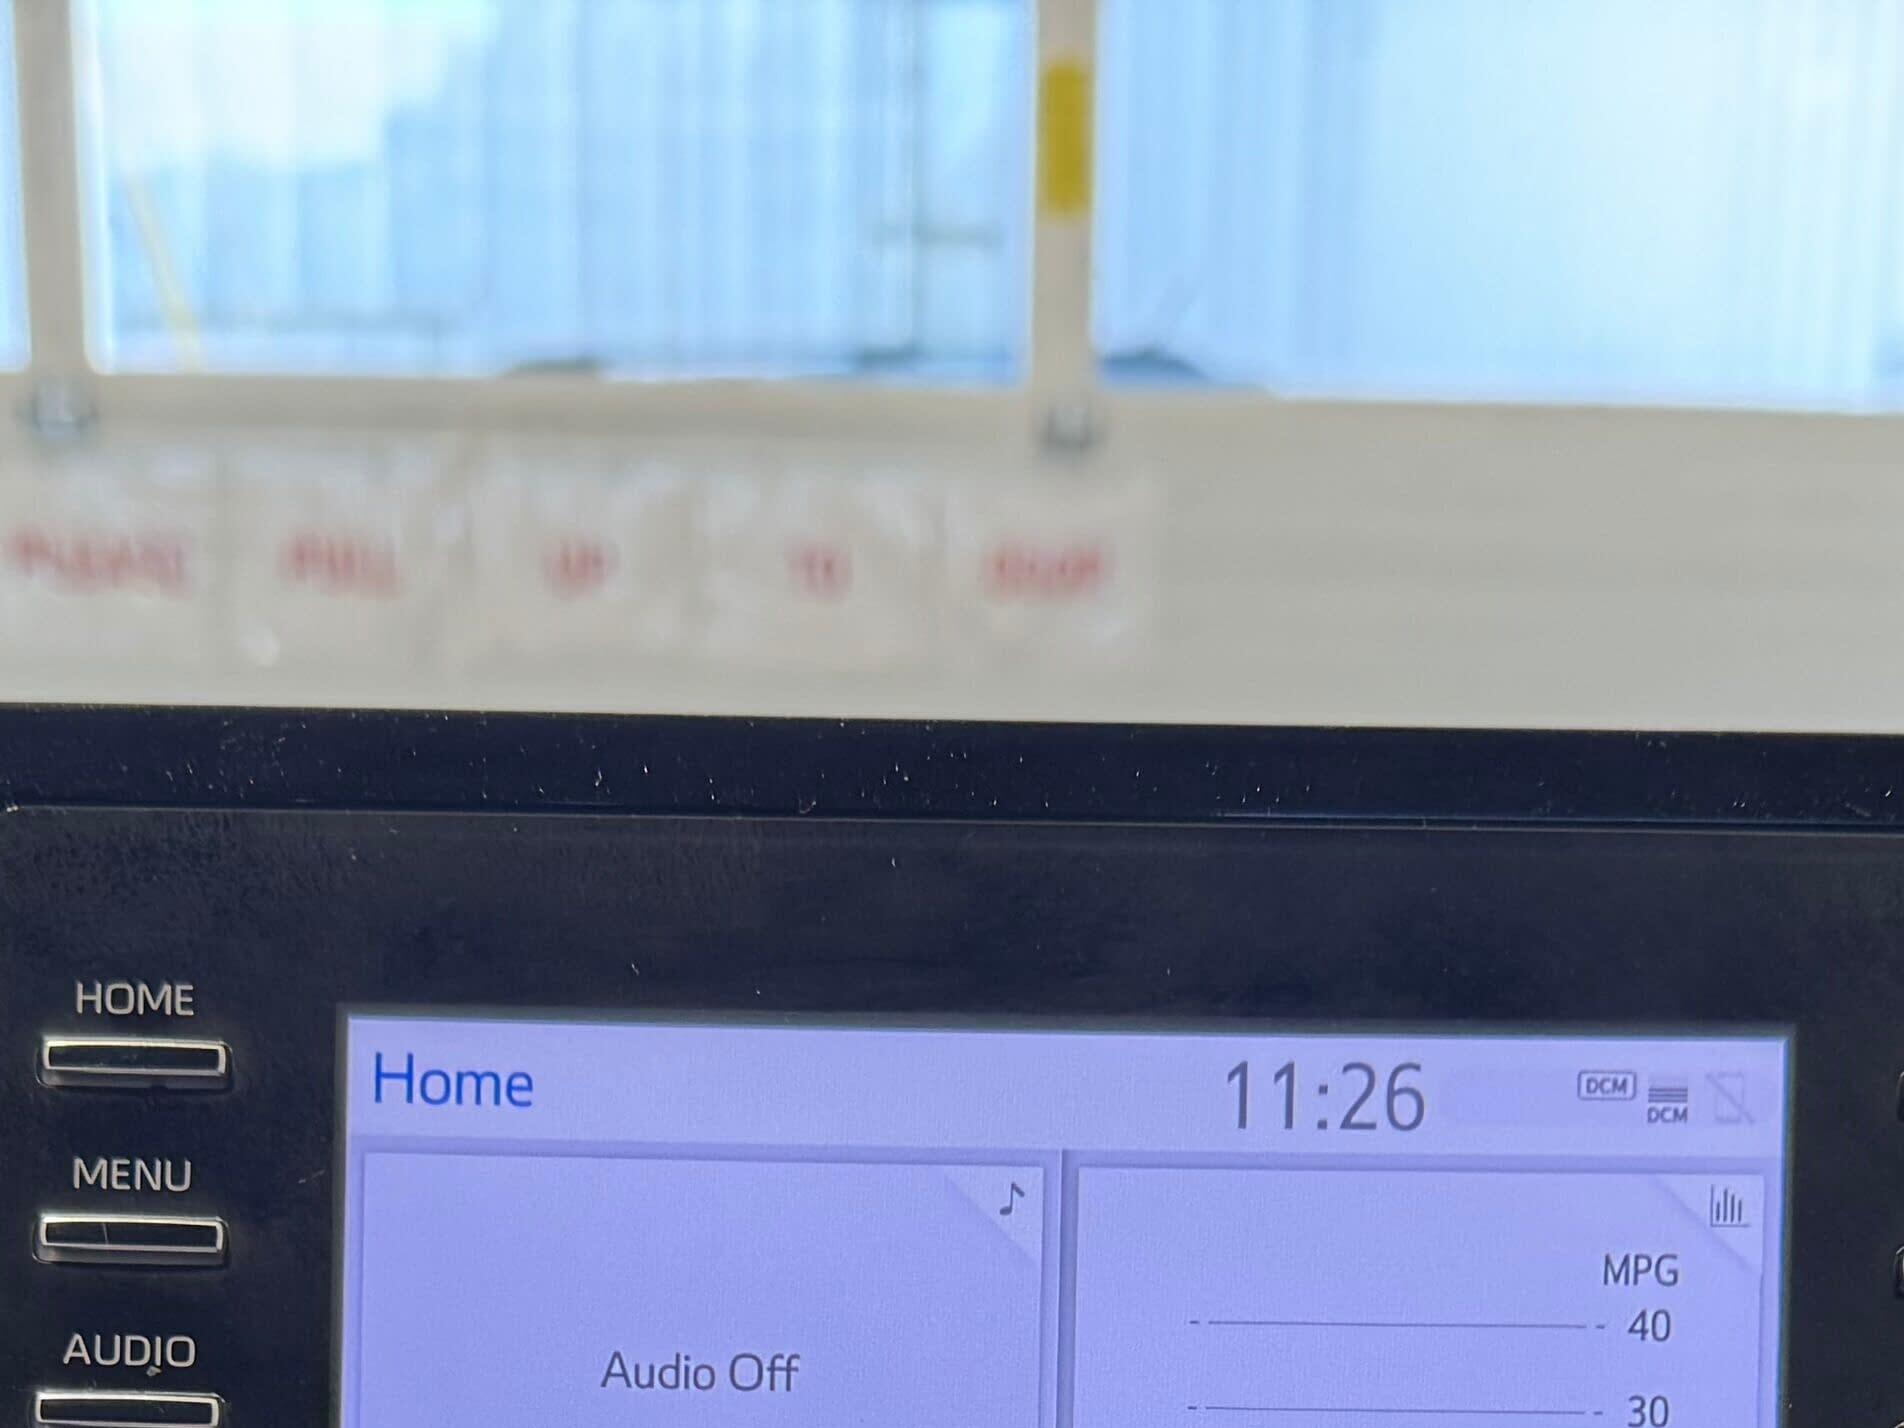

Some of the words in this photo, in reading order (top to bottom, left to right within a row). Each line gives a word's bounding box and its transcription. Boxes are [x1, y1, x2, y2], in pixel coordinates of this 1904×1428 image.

[75, 980, 195, 1016] HOME
[373, 1052, 534, 1107] Home
[1226, 1060, 1427, 1131] 11:26
[1586, 1077, 1627, 1095] DCM
[1647, 1107, 1688, 1123] DCM
[72, 1156, 192, 1192] MENU
[1602, 1253, 1679, 1288] MPG
[1626, 1309, 1672, 1343] 40
[62, 1333, 196, 1368] AUDIO
[599, 1350, 716, 1391] Audio
[728, 1352, 800, 1393] Off
[1626, 1396, 1670, 1428] 30
